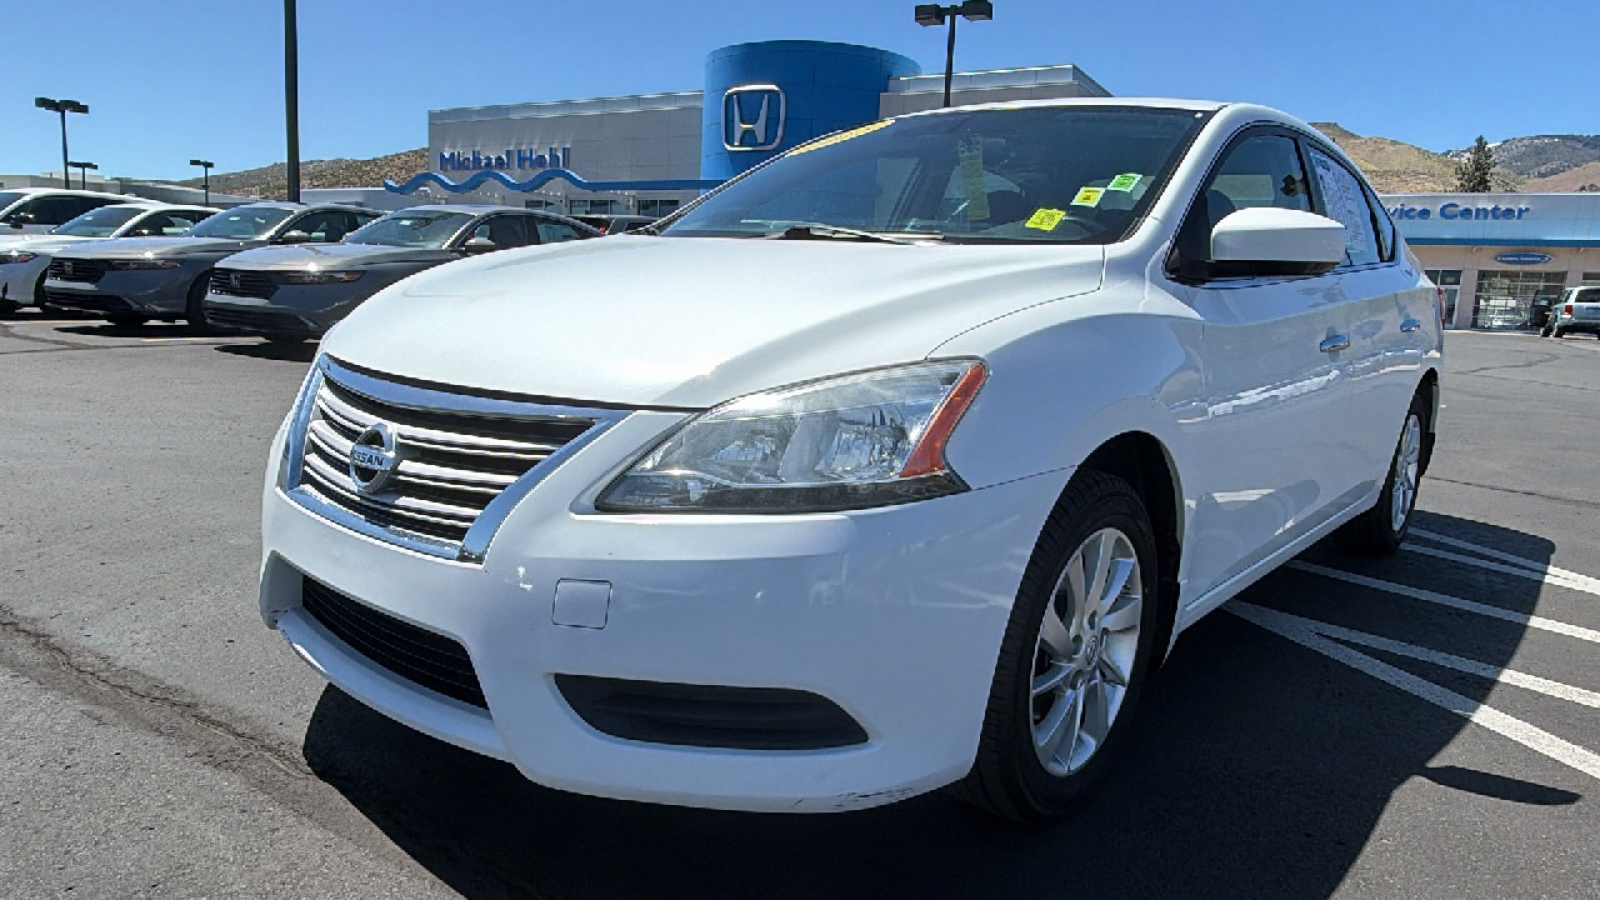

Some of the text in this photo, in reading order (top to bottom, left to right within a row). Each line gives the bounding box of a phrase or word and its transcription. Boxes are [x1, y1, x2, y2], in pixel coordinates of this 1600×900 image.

[439, 146, 571, 171] Michael Hohl
[1387, 202, 1531, 221] vice Center
